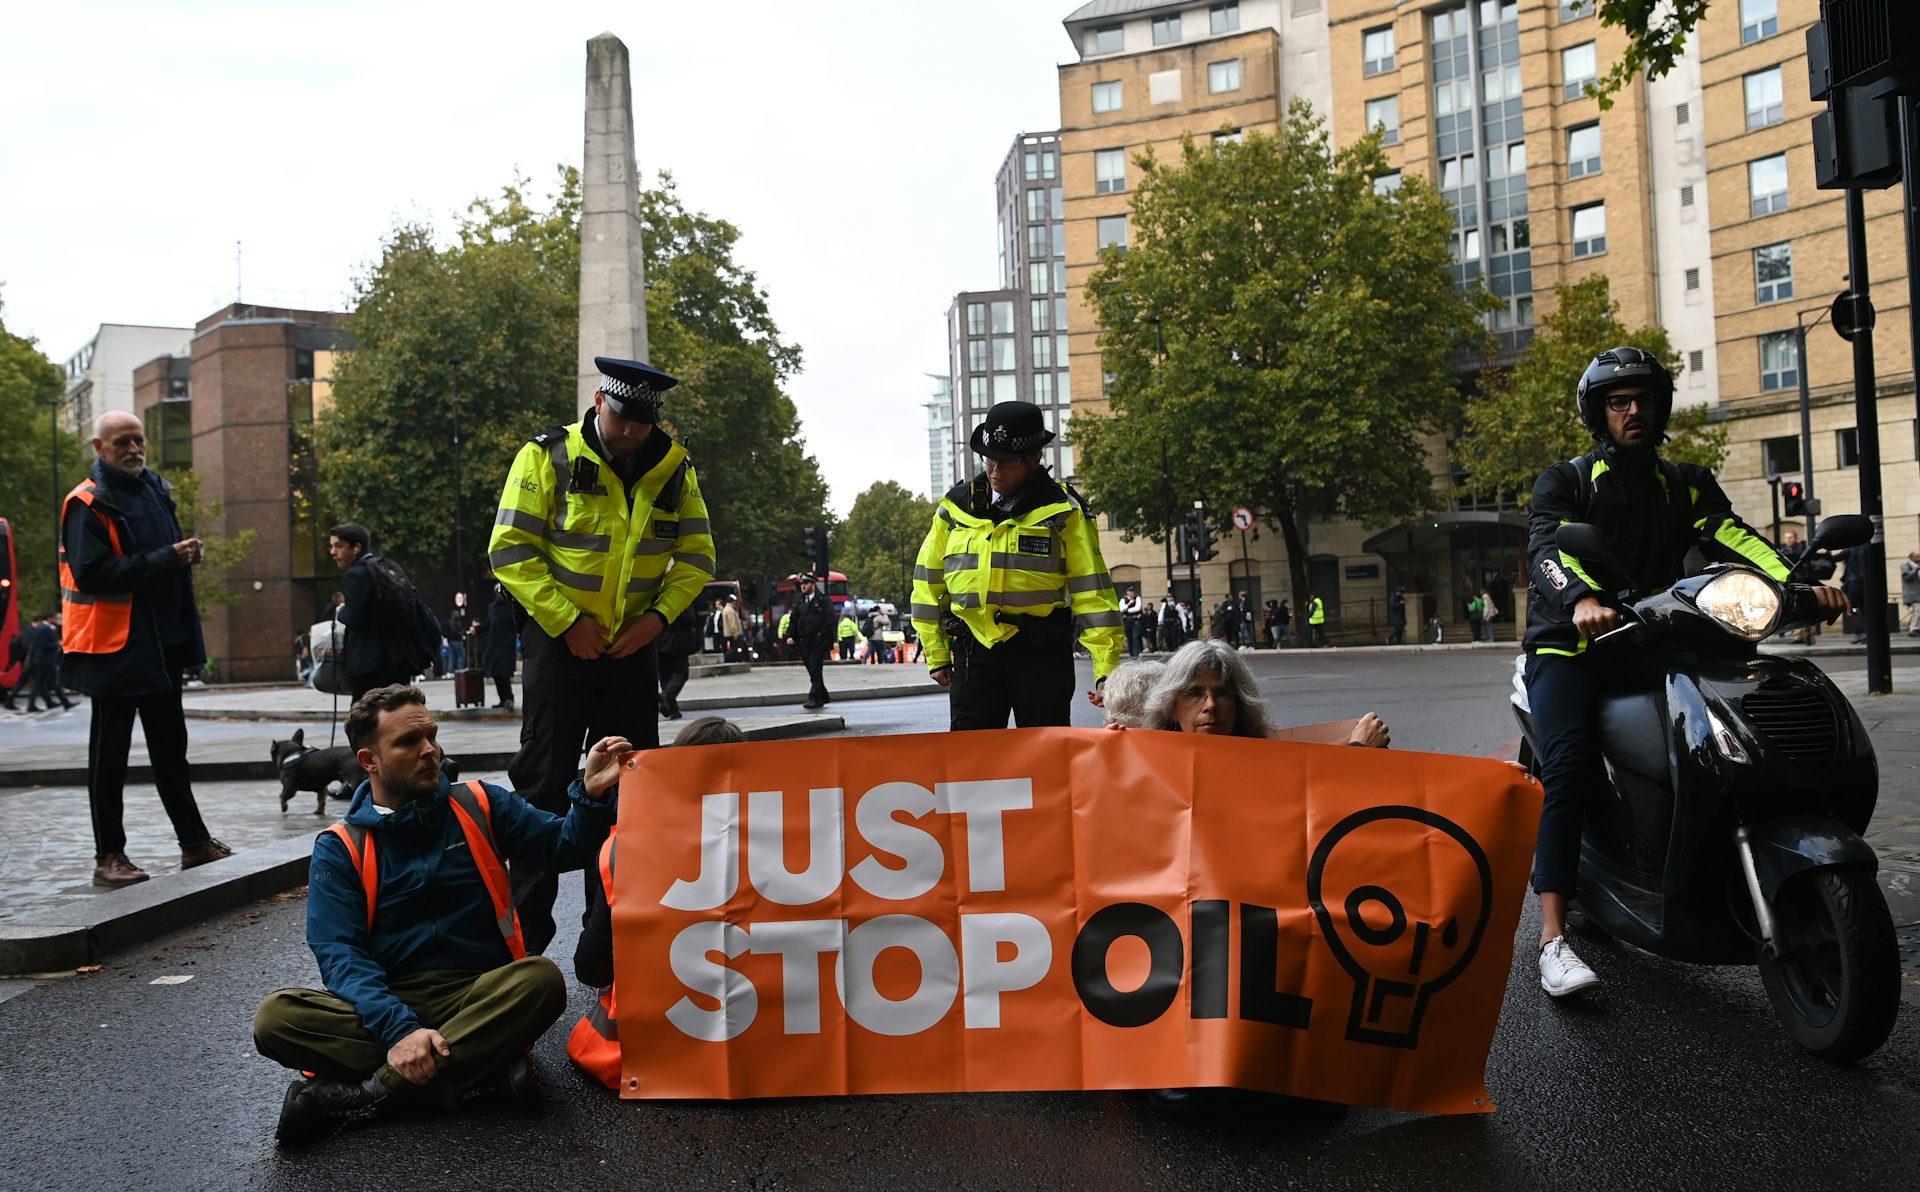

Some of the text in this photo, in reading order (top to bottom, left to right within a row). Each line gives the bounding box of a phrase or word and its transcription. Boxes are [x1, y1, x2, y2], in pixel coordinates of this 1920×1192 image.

[513, 478, 538, 493] POLICE
[659, 777, 1033, 911] JUST
[665, 900, 1313, 1042] STOP OIL
